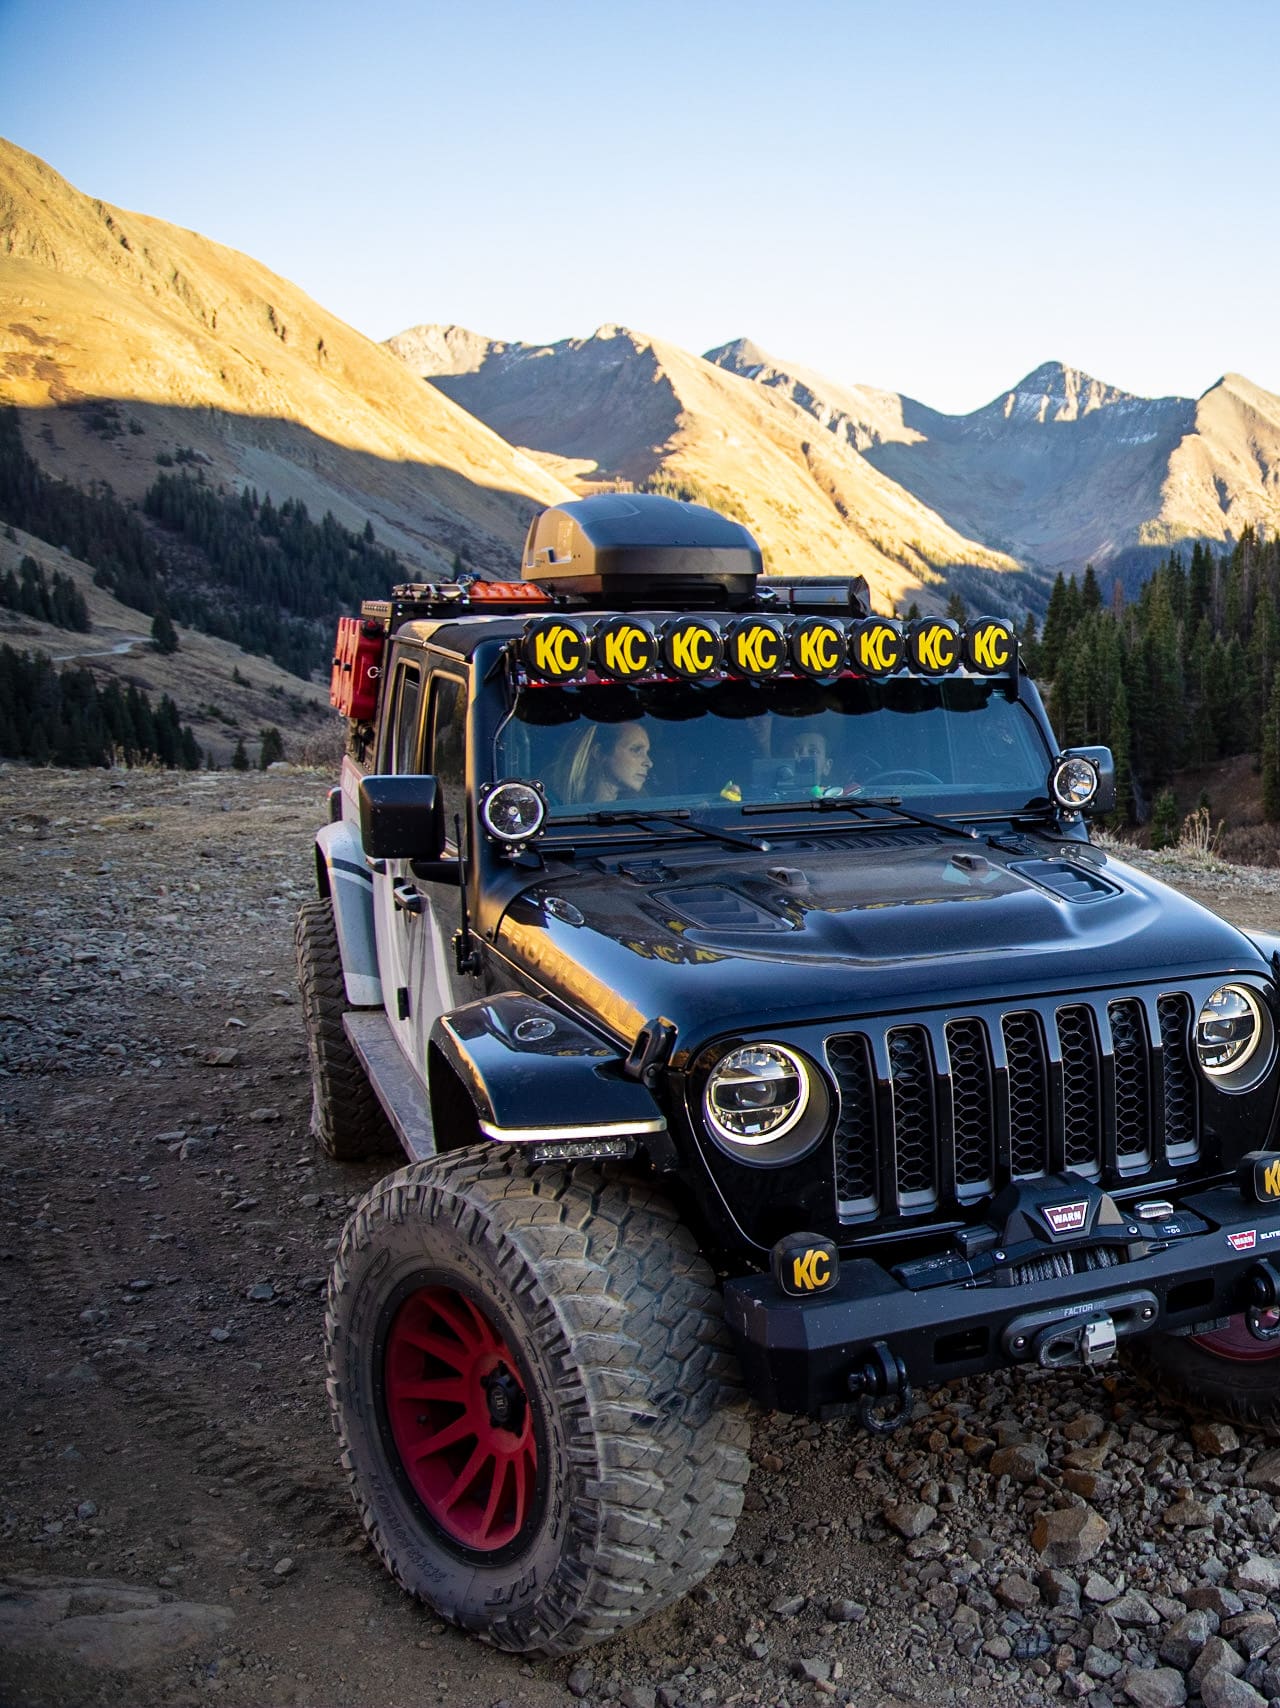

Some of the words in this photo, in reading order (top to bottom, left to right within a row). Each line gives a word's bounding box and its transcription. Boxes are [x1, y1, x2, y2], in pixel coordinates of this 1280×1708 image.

[535, 626, 579, 675] KC
[605, 626, 648, 674] KC
[672, 626, 714, 674] KC
[737, 626, 777, 673] KC
[800, 626, 838, 672] KC
[860, 626, 897, 671] KC
[918, 625, 954, 670] KC
[974, 625, 1008, 669] KC
[1052, 1210, 1082, 1225] WARN
[793, 1249, 831, 1290] KC
[1063, 1303, 1094, 1317] FACTOR
